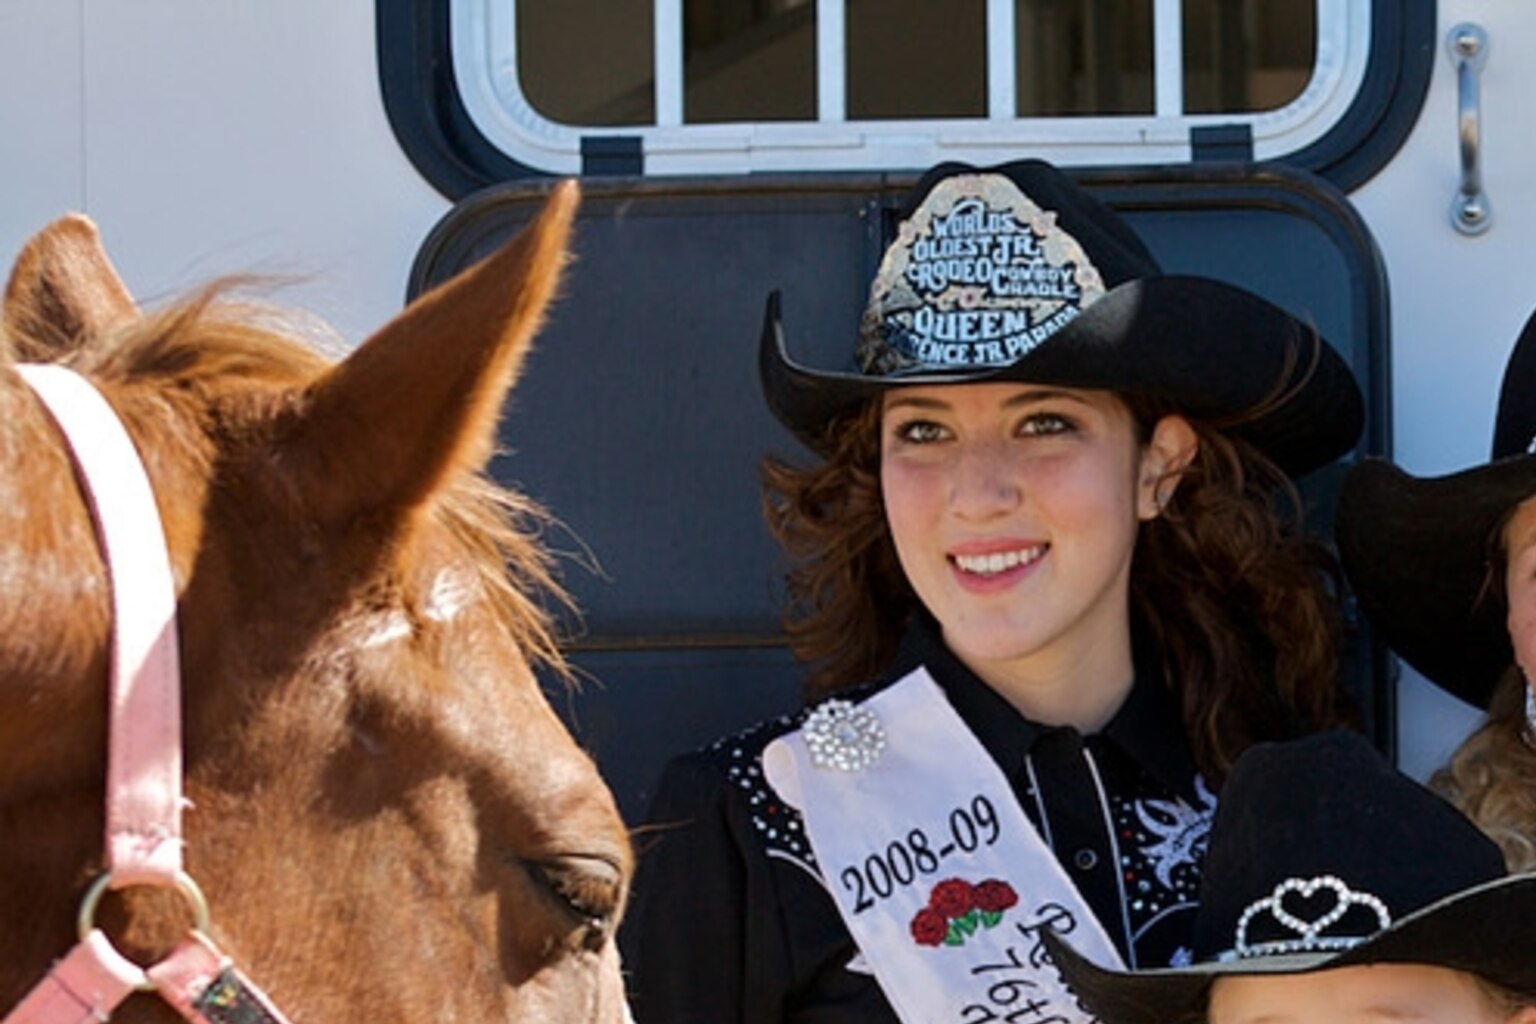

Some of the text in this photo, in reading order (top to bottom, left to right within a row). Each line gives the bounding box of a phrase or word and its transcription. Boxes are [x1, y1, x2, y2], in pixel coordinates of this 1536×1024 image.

[914, 238, 993, 261] OLDEST
[908, 257, 993, 292] RODEO
[914, 305, 1026, 340] QUEEN
[842, 795, 1000, 914] 2008-09
